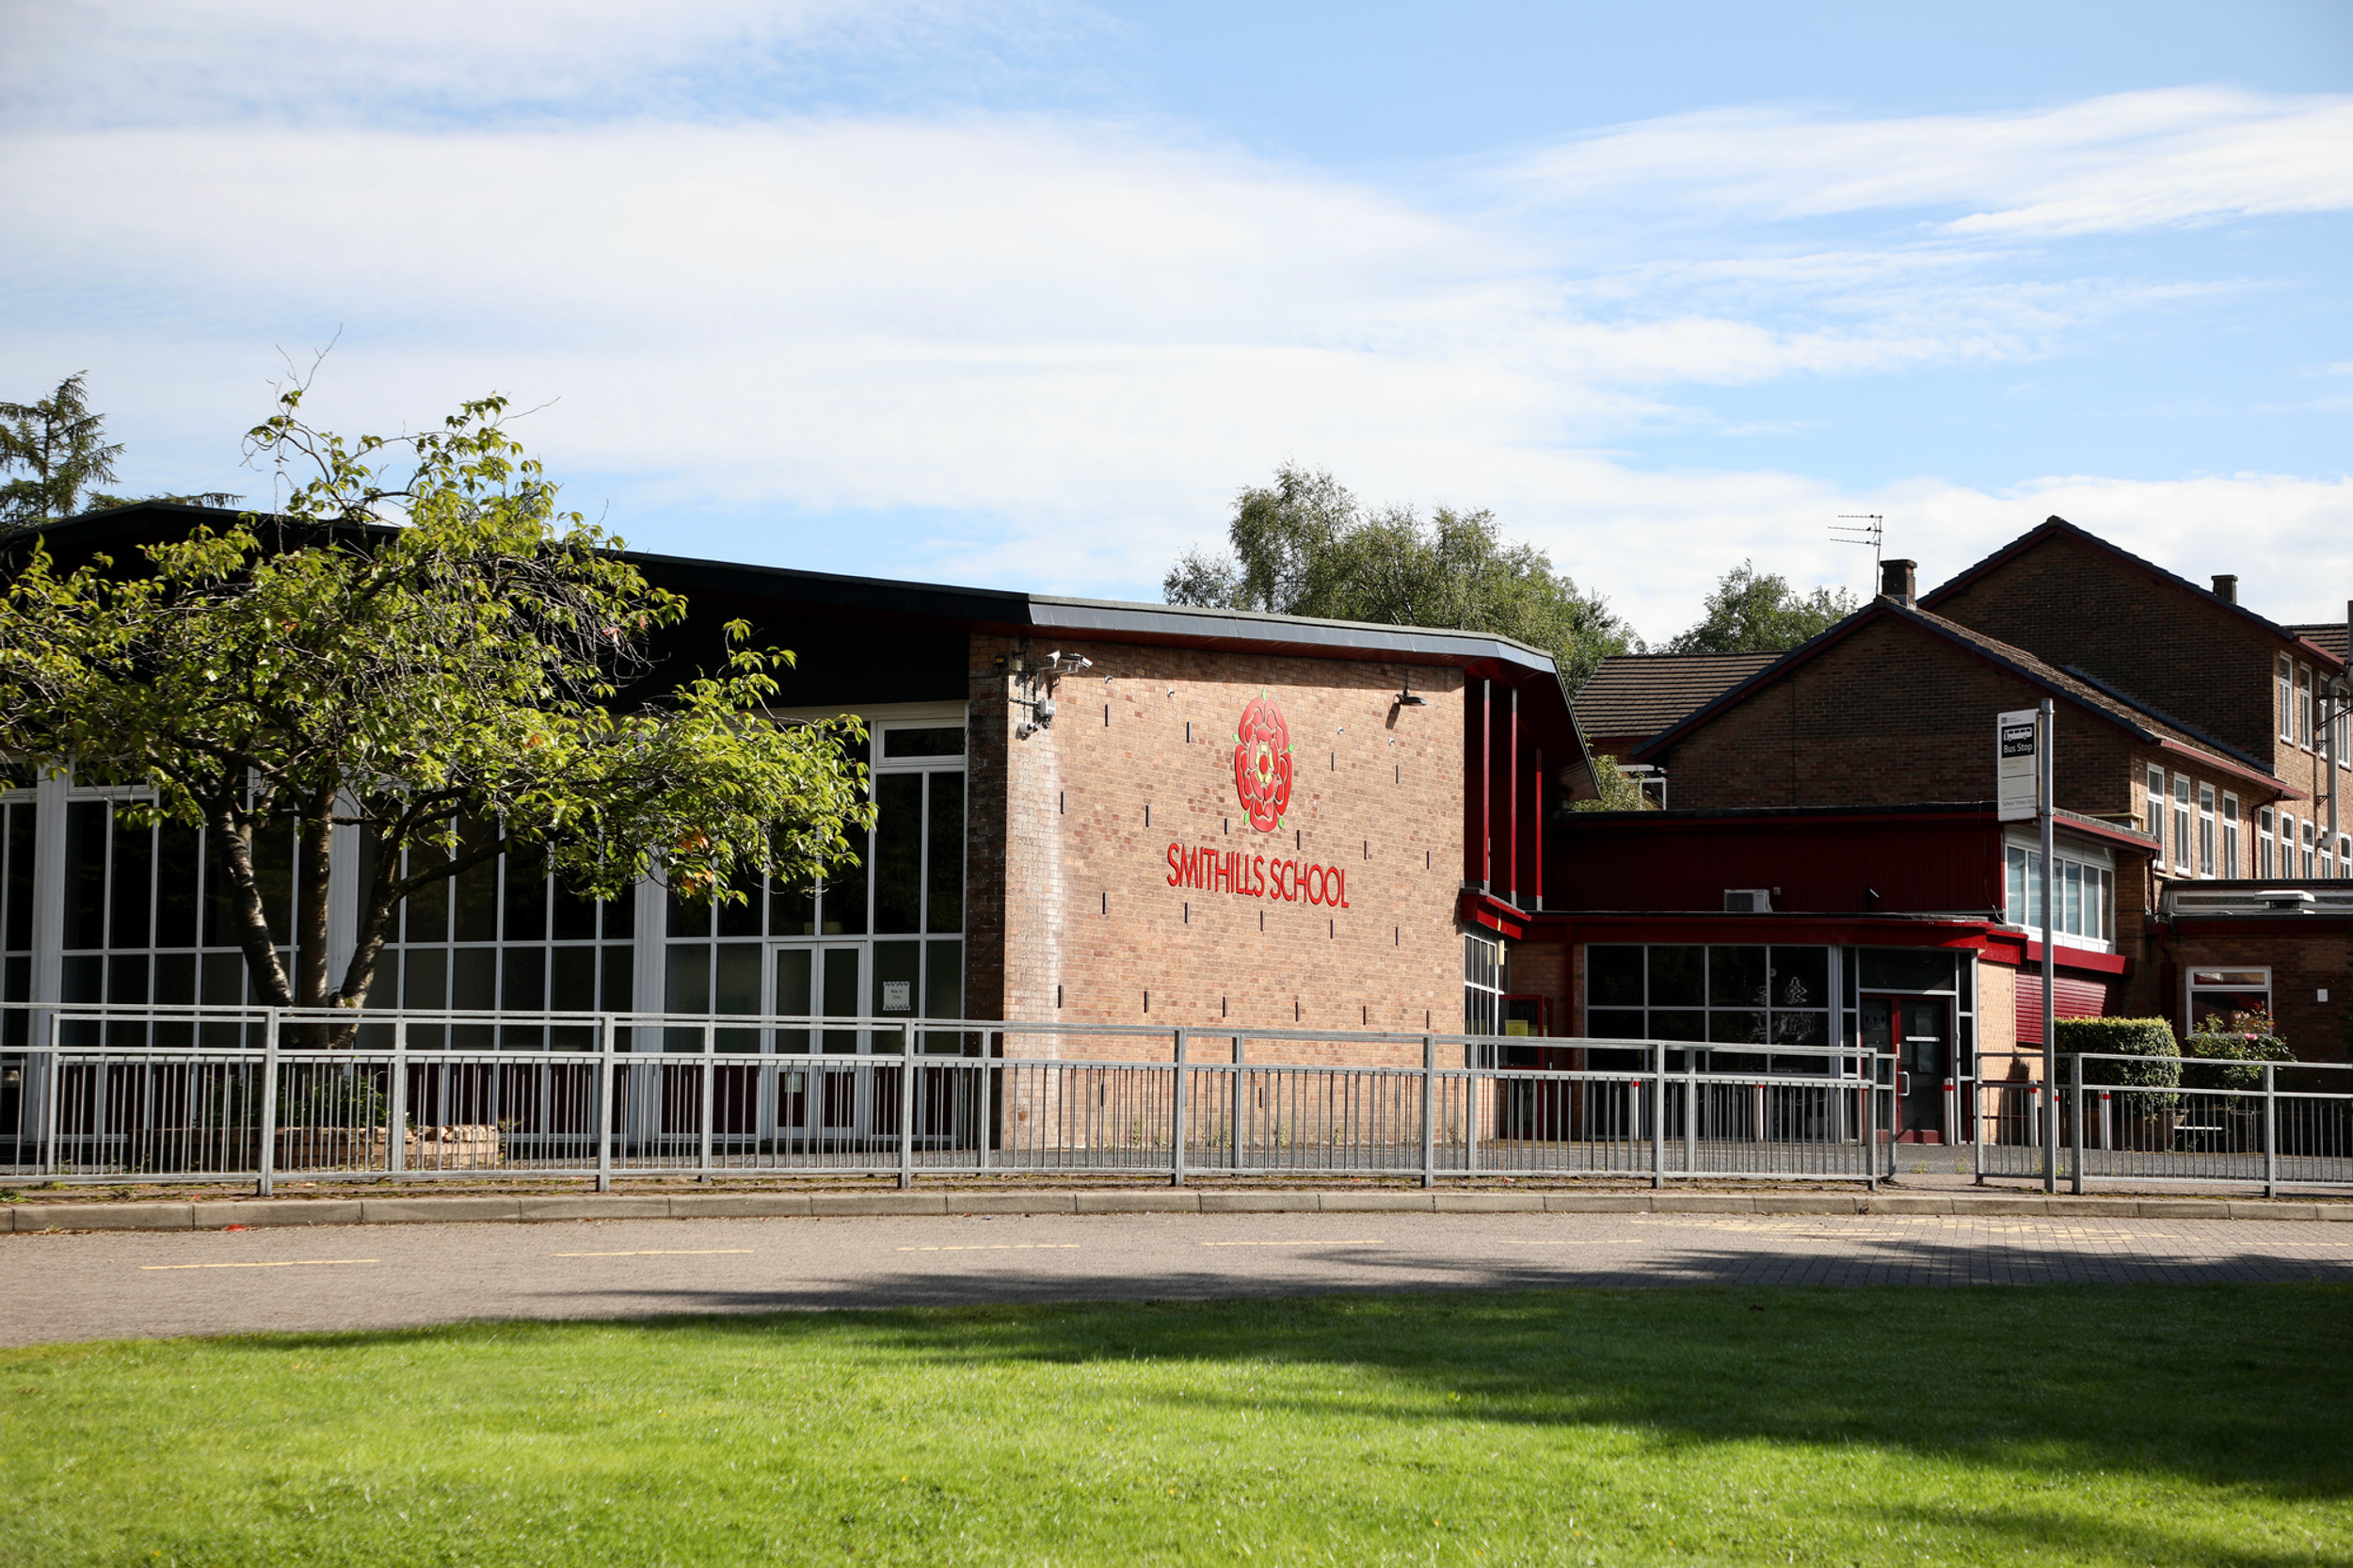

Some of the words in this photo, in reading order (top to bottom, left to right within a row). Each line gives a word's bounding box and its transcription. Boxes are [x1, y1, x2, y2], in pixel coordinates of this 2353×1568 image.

[2004, 744, 2016, 753] Bus
[2017, 743, 2032, 752] Stop
[1167, 842, 1265, 897] SMITHILLS
[1270, 858, 1350, 908] SCHOOL
